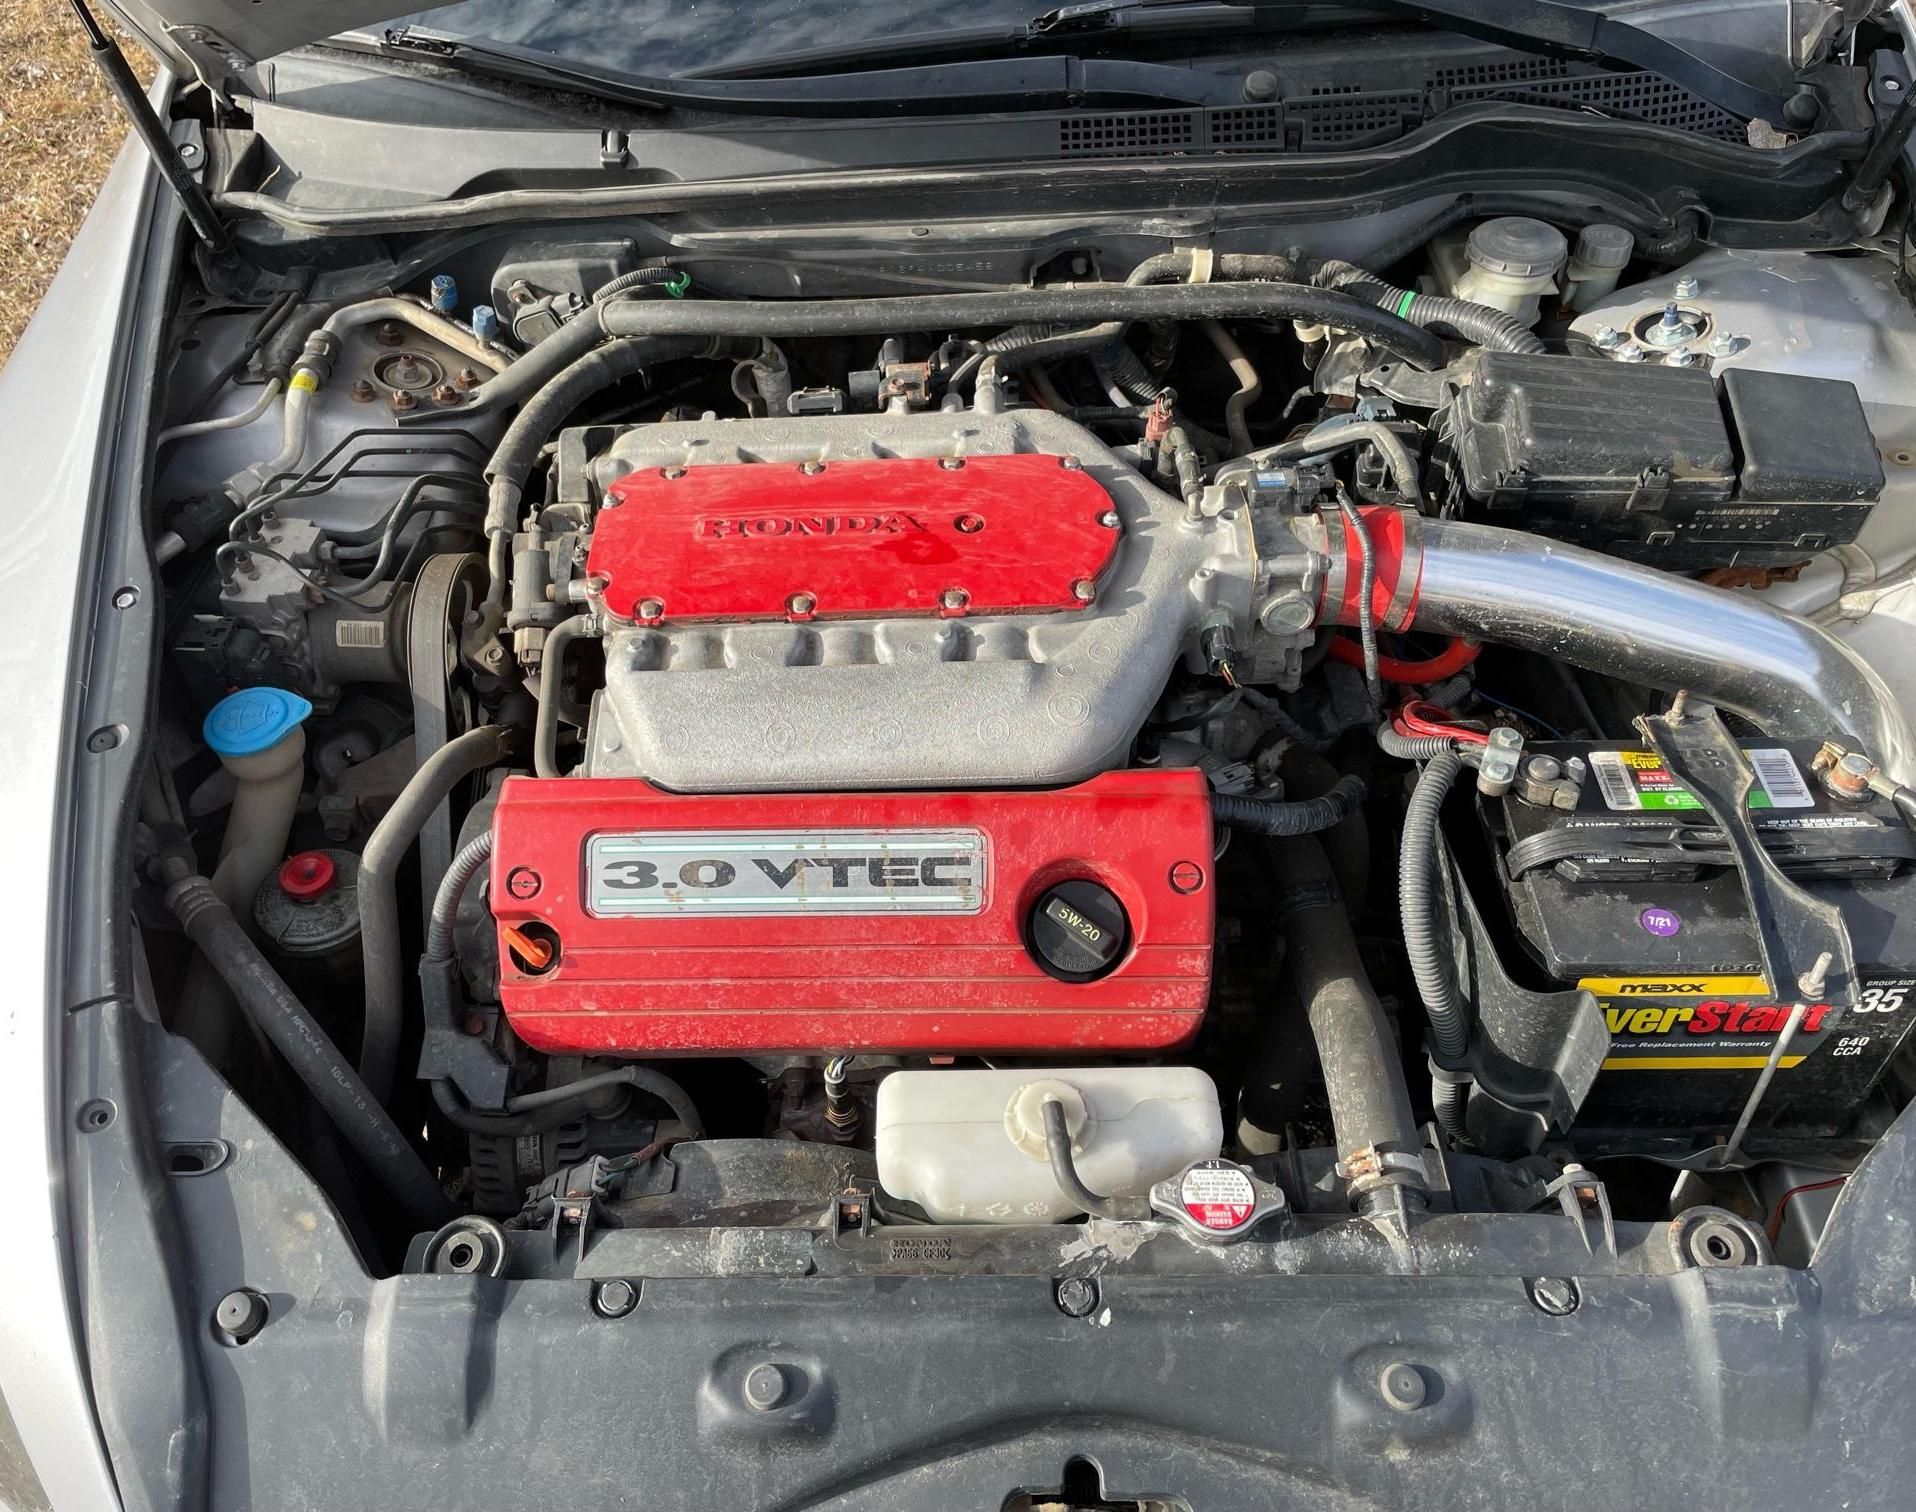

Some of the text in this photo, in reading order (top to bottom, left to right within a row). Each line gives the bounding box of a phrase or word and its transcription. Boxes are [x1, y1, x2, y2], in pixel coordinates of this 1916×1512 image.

[696, 510, 928, 538] HONDA
[603, 857, 972, 890] 3.0 VTEC
[1058, 907, 1101, 941] 5W-20
[1619, 983, 1708, 993] maxx
[1853, 988, 1909, 1013] 35
[1601, 1001, 1832, 1033] verStart
[1638, 1041, 1716, 1050] Replacement
[1719, 1040, 1772, 1049] Warranty
[1832, 1047, 1862, 1056] CCA
[1838, 1036, 1870, 1047] 640
